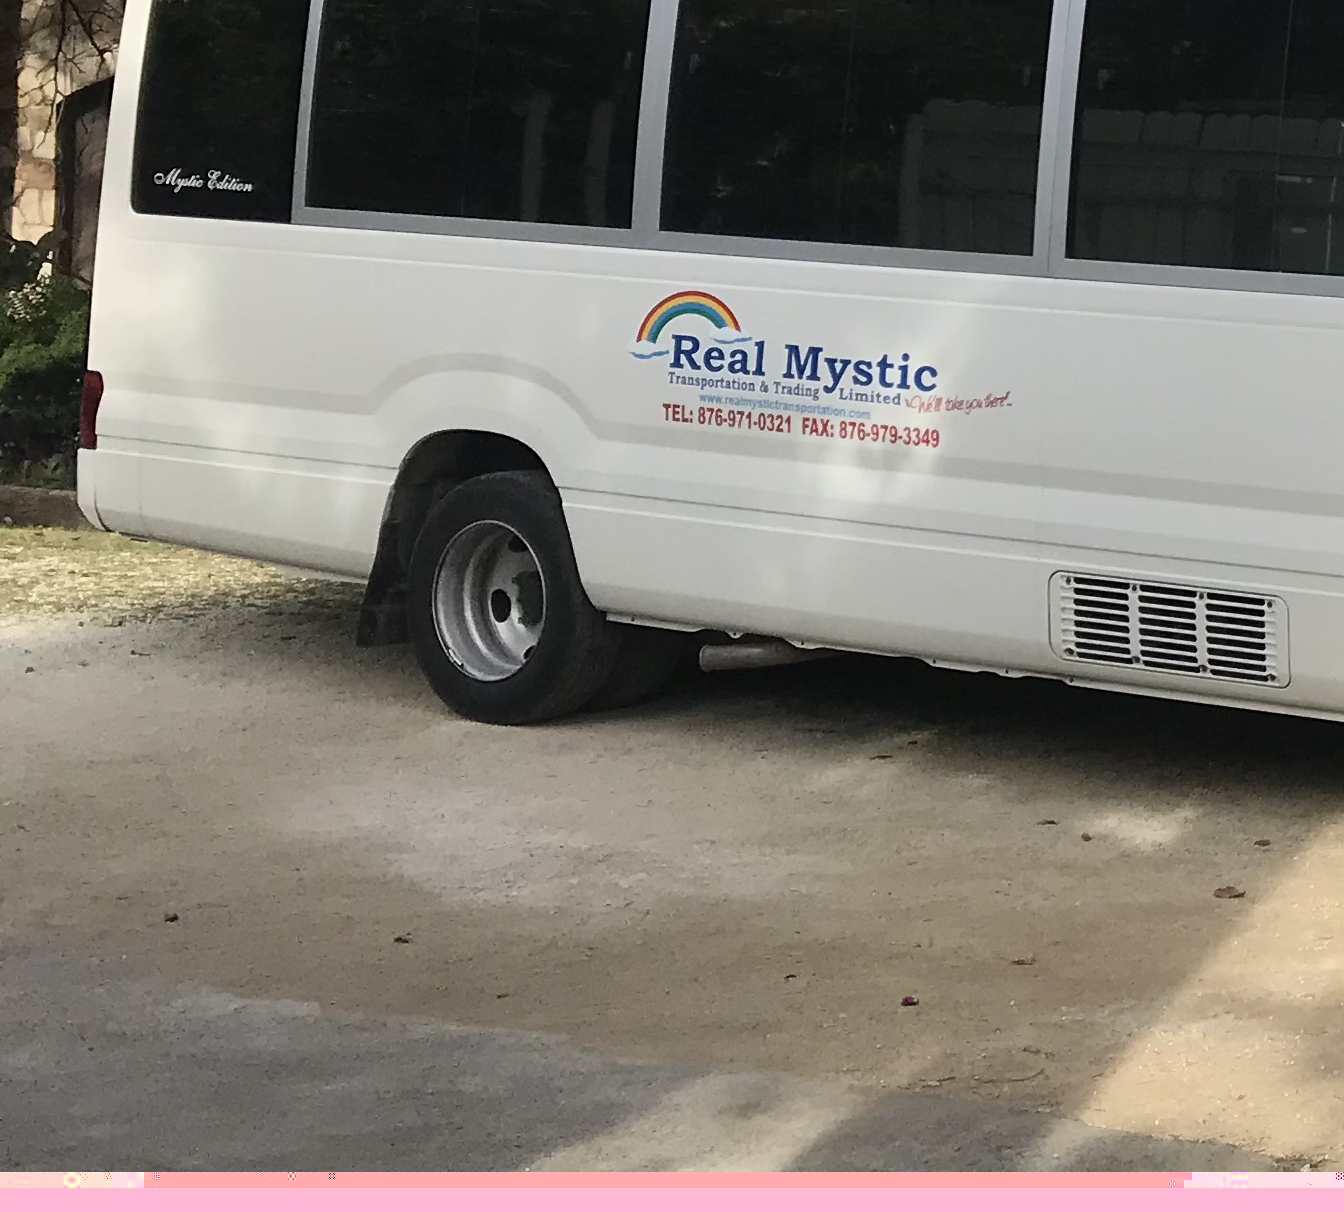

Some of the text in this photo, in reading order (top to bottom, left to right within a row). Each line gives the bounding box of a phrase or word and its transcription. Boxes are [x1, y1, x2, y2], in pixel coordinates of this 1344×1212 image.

[153, 168, 253, 193] Mystic Edition
[669, 334, 938, 394] Real Mystic
[668, 372, 902, 406] Transportation & Trading Limited
[662, 403, 940, 448] TEL: 876-971-0321 FAX: 876-979-3349
